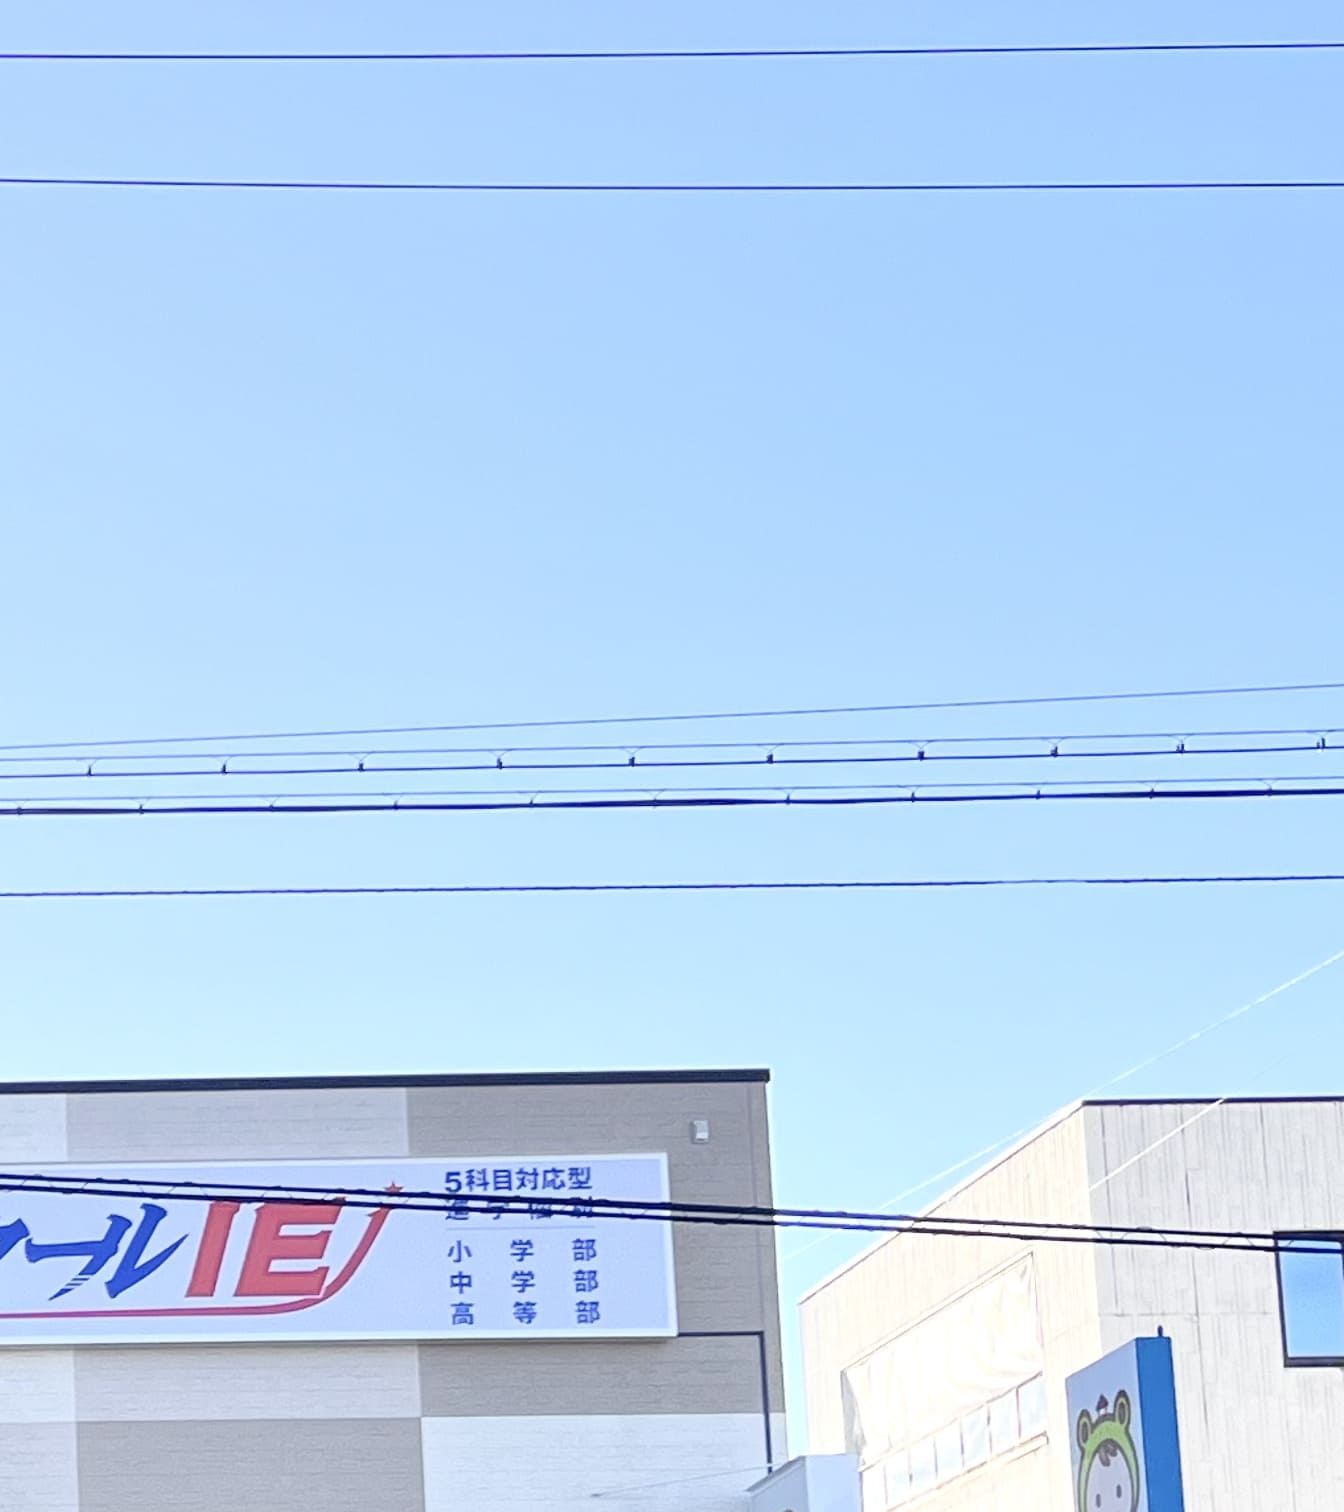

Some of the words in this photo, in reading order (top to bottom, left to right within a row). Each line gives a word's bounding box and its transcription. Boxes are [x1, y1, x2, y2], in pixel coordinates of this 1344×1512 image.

[445, 1167, 593, 1193] 5科目対応型
[447, 1238, 598, 1263] 小学部
[449, 1269, 600, 1295] 中学部
[450, 1300, 602, 1326] 高等部
